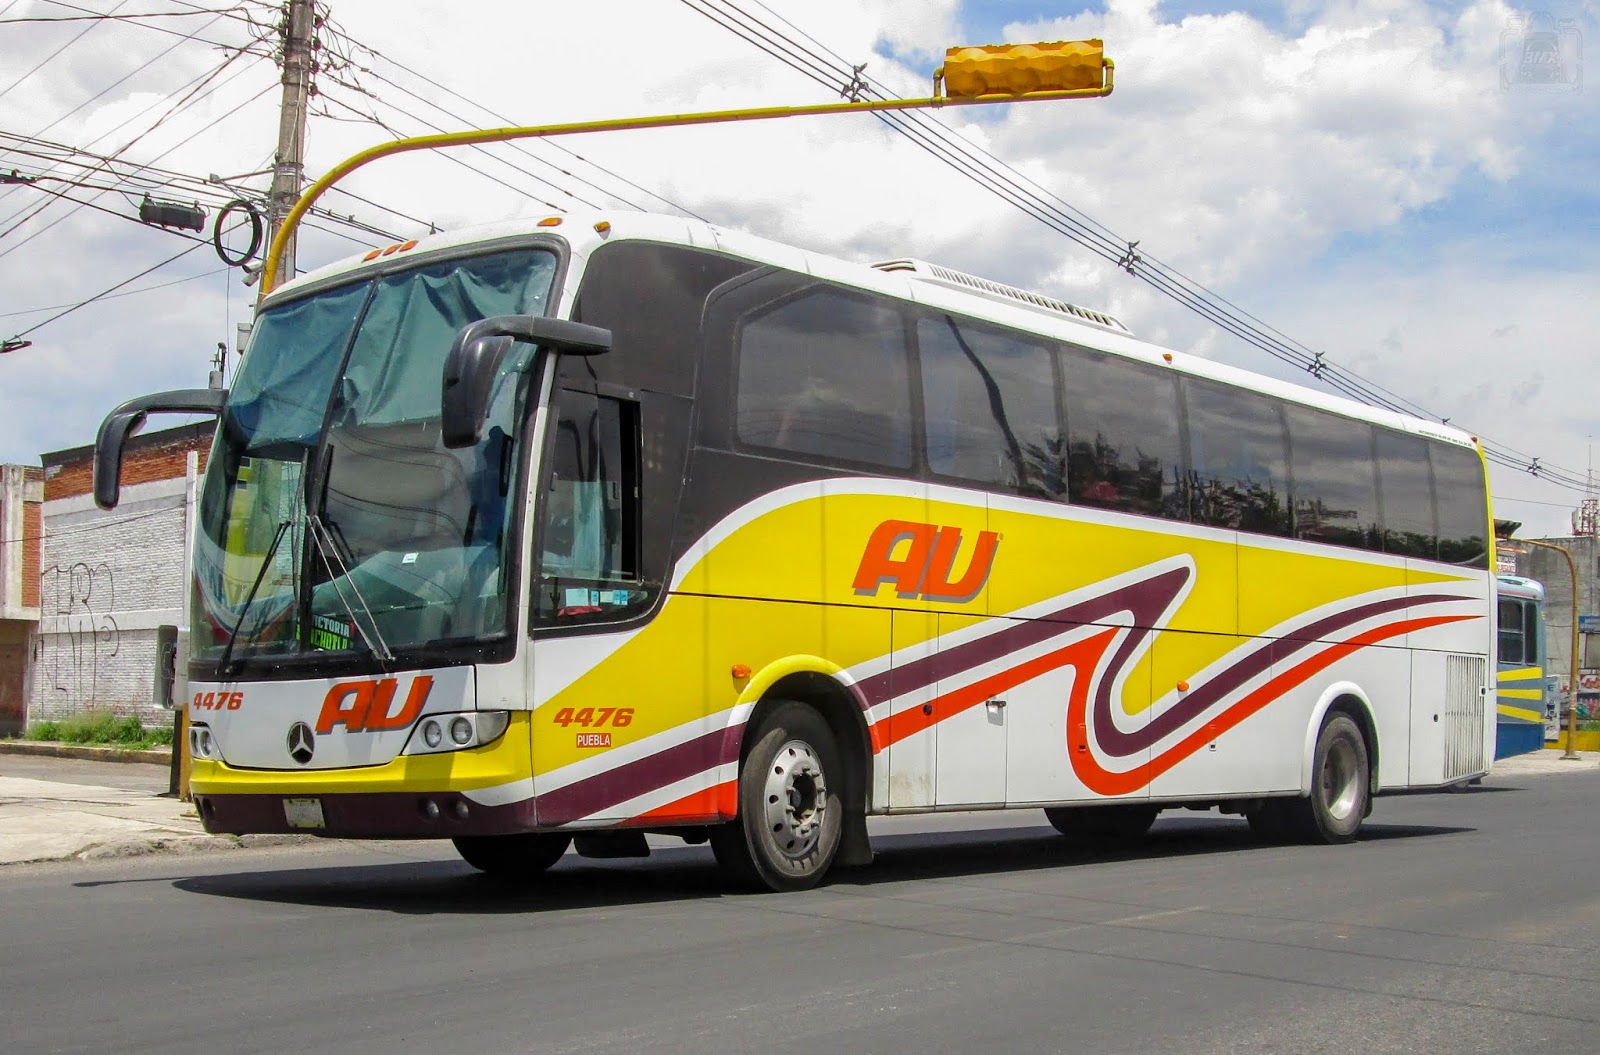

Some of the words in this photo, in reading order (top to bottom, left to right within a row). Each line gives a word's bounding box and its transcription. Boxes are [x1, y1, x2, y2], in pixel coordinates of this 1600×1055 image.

[852, 519, 1000, 604] AU
[193, 691, 244, 711] 4476
[314, 675, 434, 735] AU
[553, 707, 635, 728] 4476
[576, 733, 611, 747] PUEBLA
